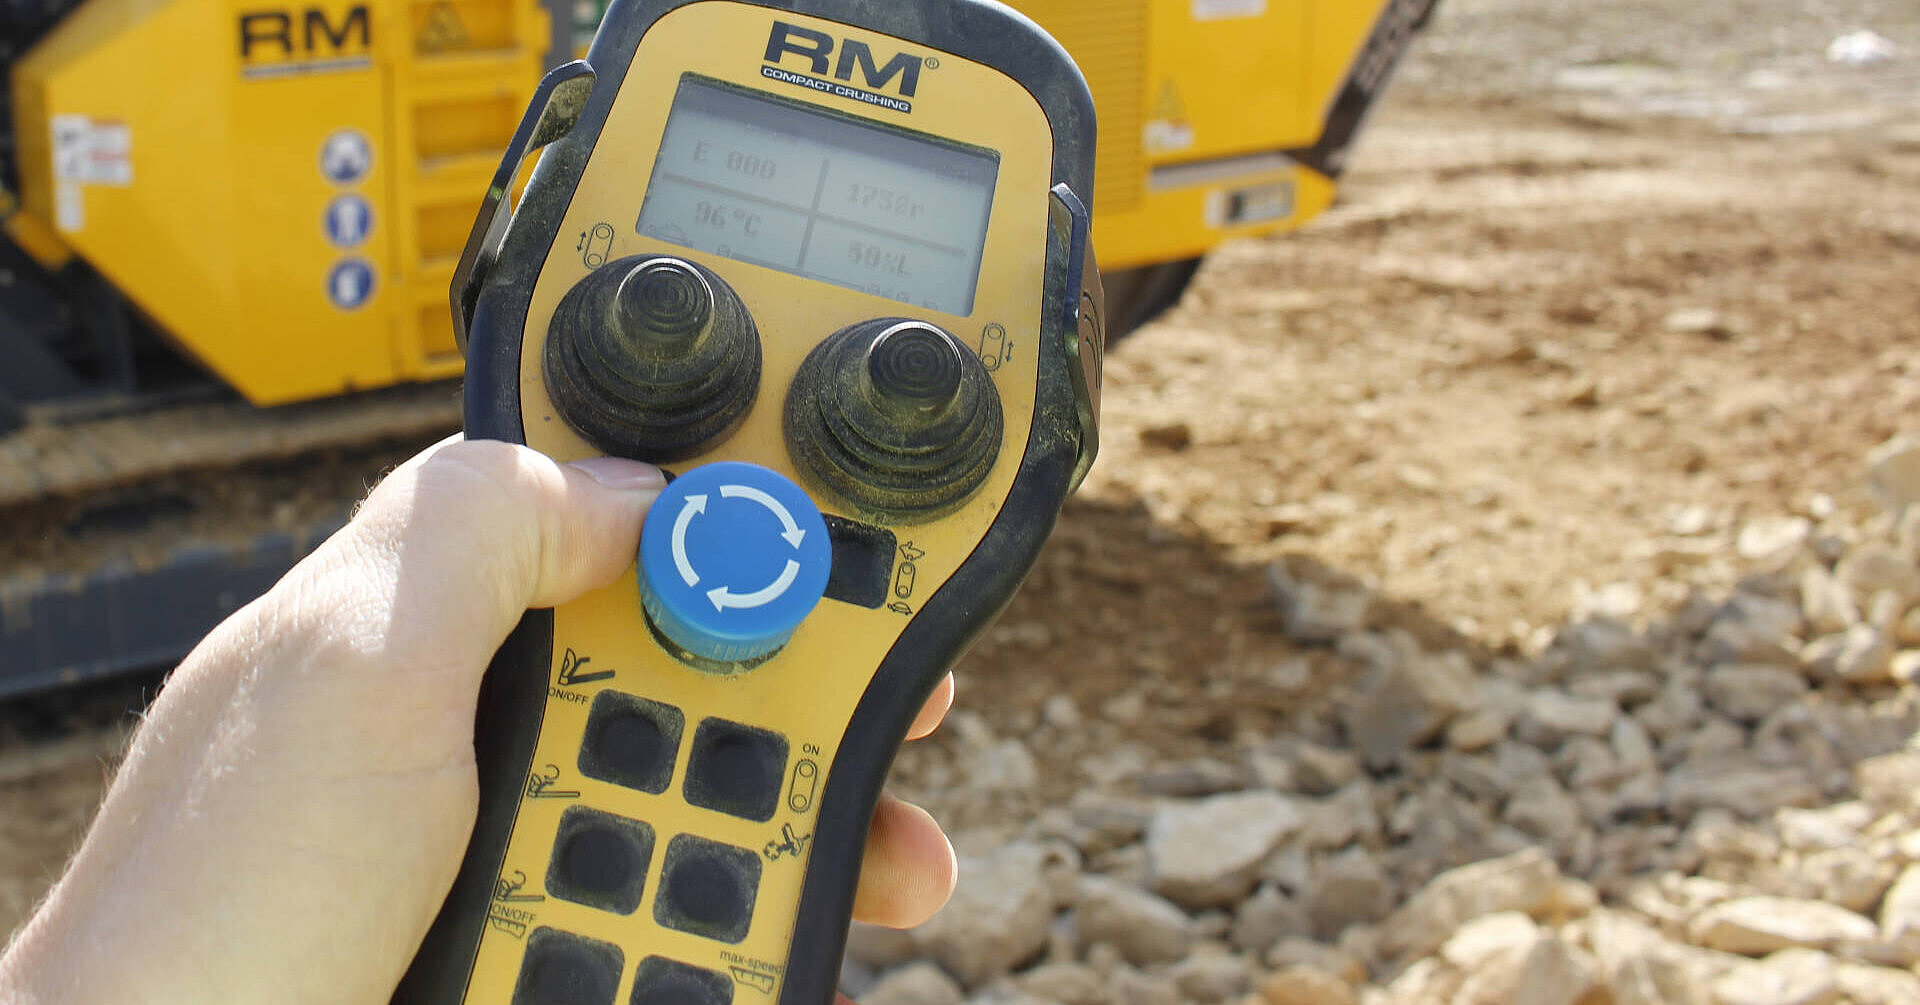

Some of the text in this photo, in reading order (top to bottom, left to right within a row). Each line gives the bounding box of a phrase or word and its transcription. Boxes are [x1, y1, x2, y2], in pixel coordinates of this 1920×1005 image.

[241, 7, 370, 57] RM
[763, 67, 911, 112] COMPACT CRUSHING
[548, 686, 589, 705] ON/OFF
[803, 743, 820, 756] ON
[492, 902, 537, 925] ON/OFF
[720, 950, 785, 979] max-speed
